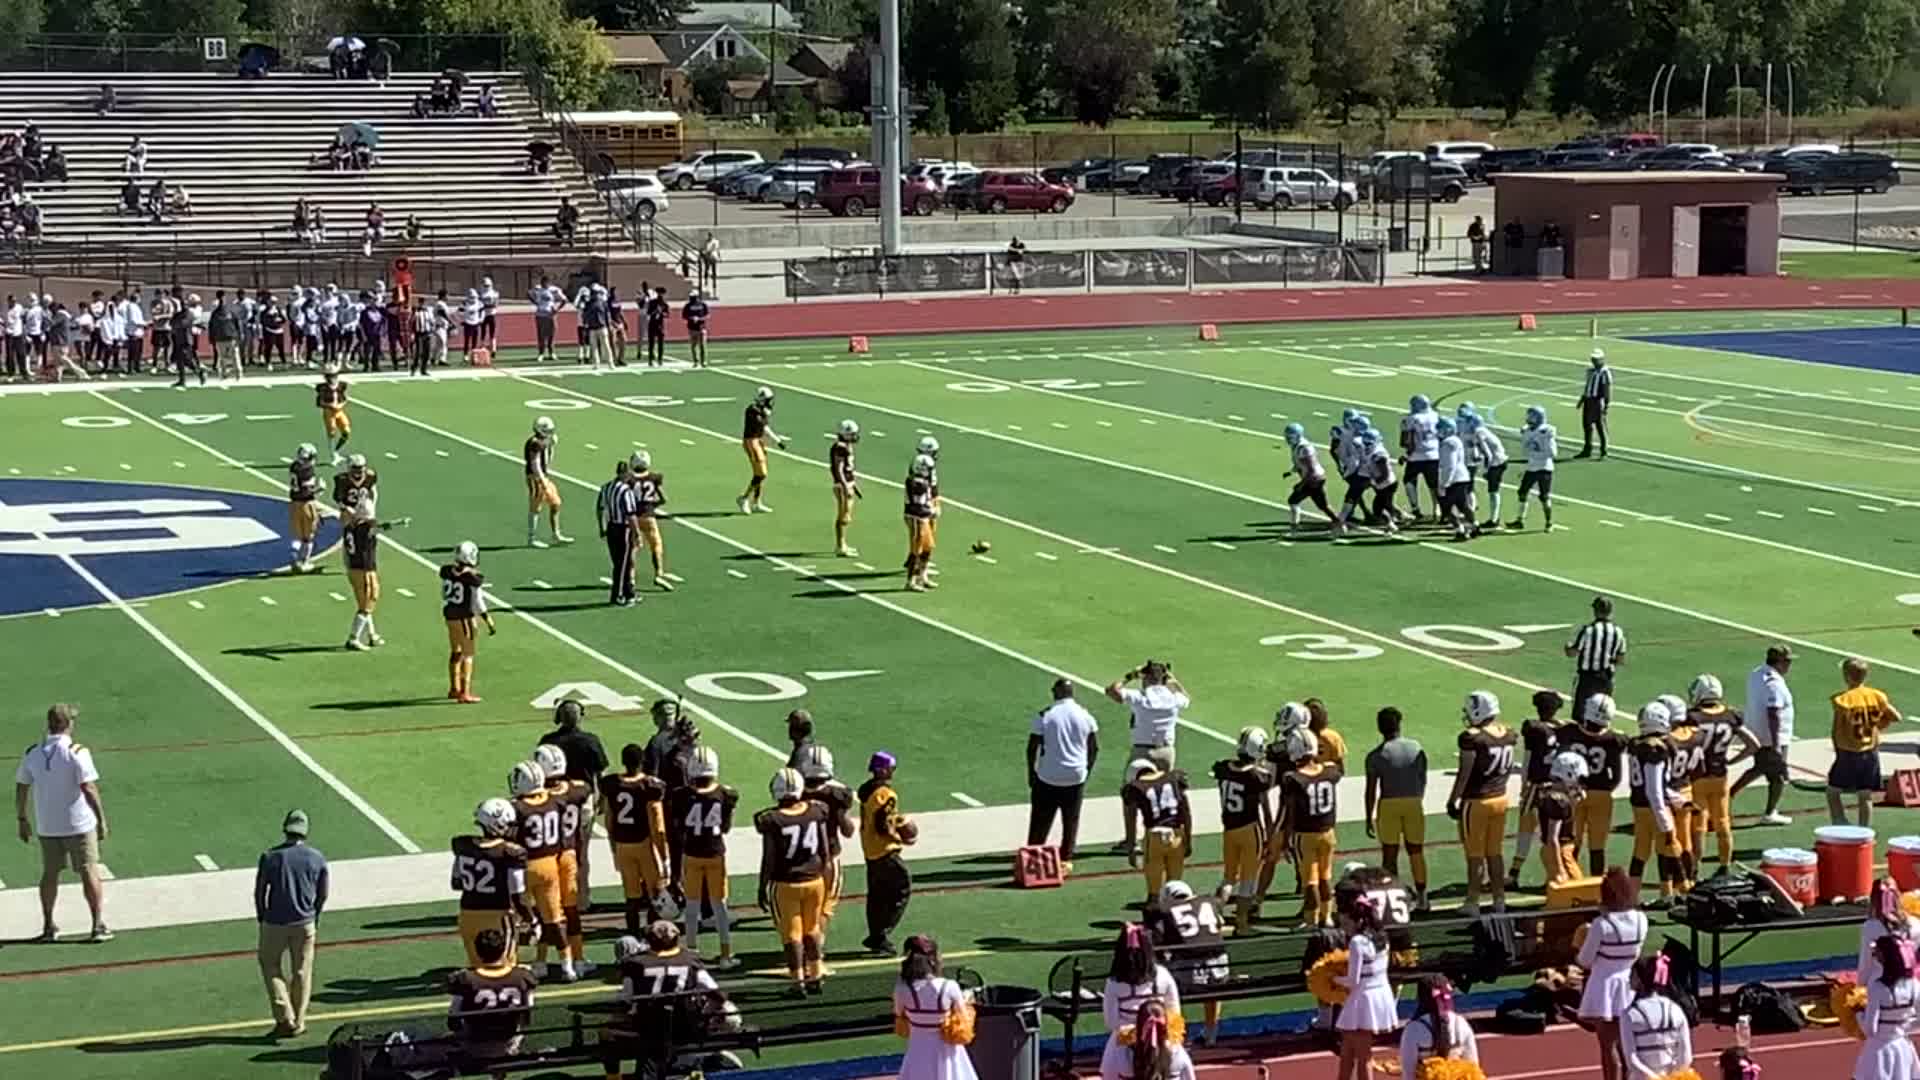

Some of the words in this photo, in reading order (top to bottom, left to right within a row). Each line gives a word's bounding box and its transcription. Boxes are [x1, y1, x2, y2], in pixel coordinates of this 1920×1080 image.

[1259, 624, 1525, 660] 30
[530, 672, 808, 711] 40
[616, 791, 635, 824] 2
[1146, 783, 1179, 818] 14
[1307, 780, 1334, 815] 10
[525, 810, 560, 848] 30
[685, 802, 722, 836] 44
[782, 821, 818, 859] 74
[459, 855, 497, 893] 52
[1170, 902, 1218, 937] 54
[1366, 888, 1410, 923] 75
[643, 966, 689, 994] 77
